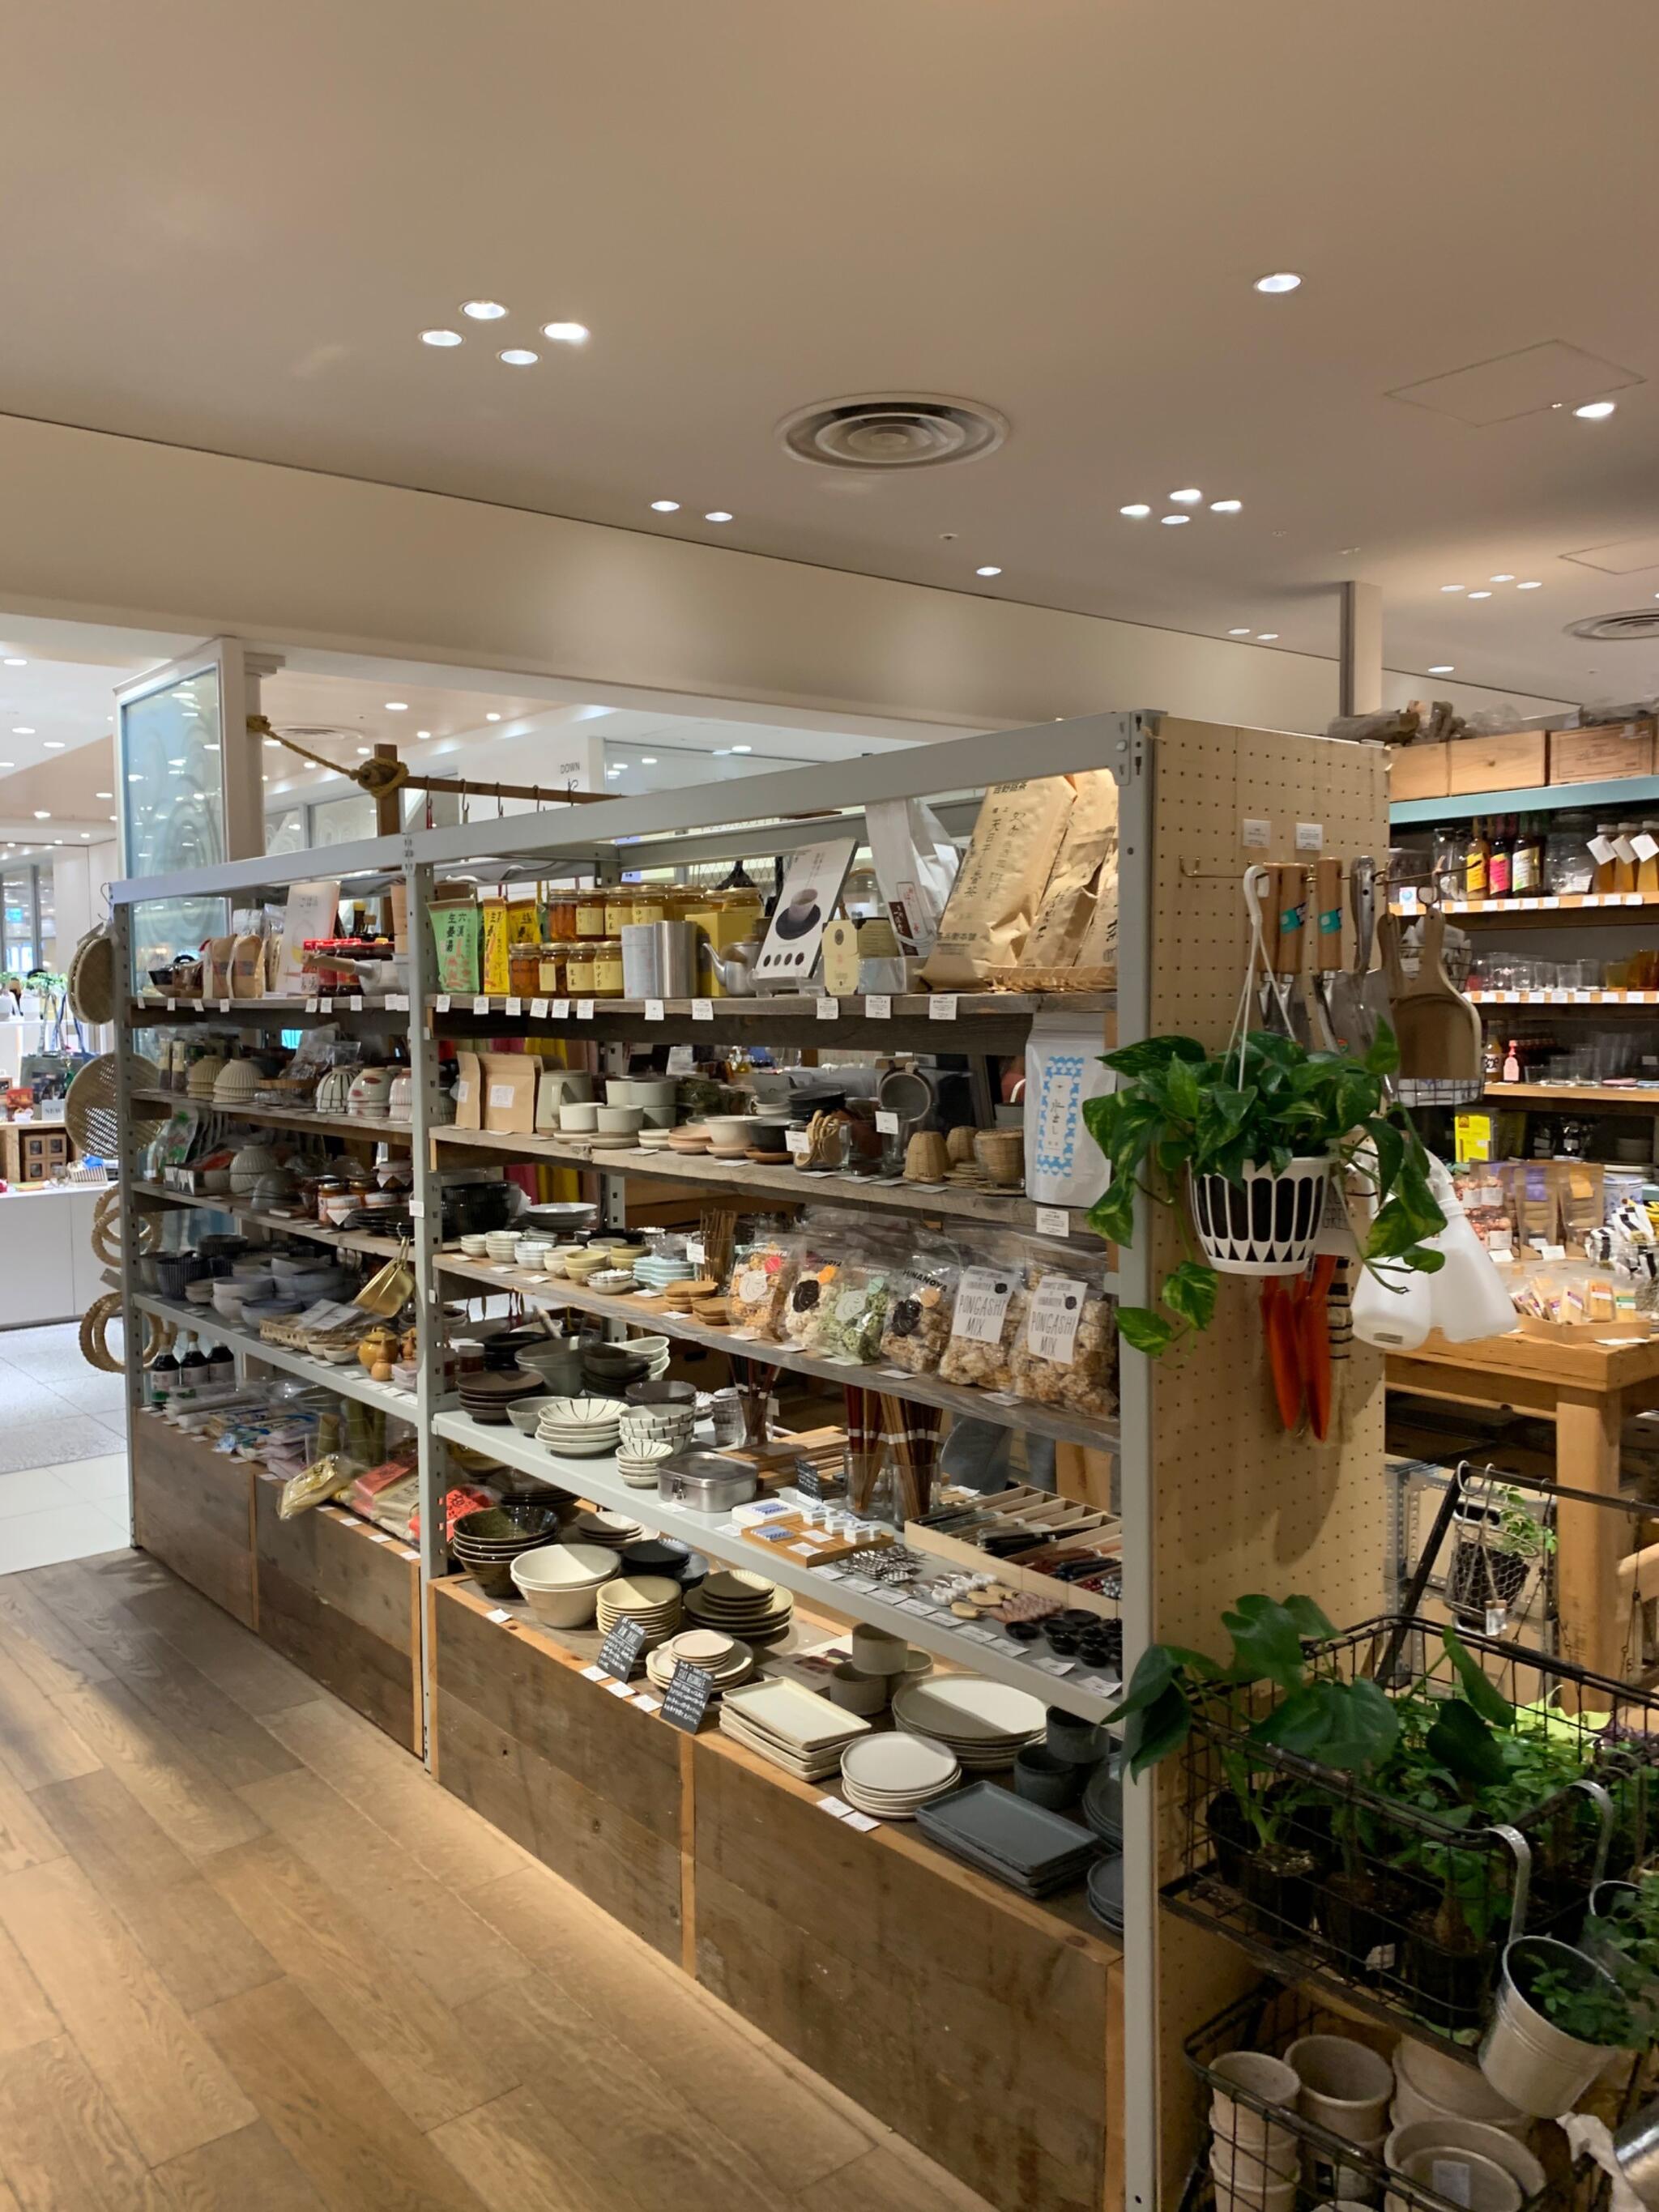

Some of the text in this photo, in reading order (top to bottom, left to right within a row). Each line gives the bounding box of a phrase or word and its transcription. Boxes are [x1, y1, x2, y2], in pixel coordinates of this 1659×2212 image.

[902, 1269, 948, 1293] HINANOYA
[957, 1294, 1007, 1318] PONGASHI
[965, 1316, 986, 1337] MIX
[1030, 1311, 1077, 1336] PONGASHI
[1038, 1336, 1058, 1357] MIX
